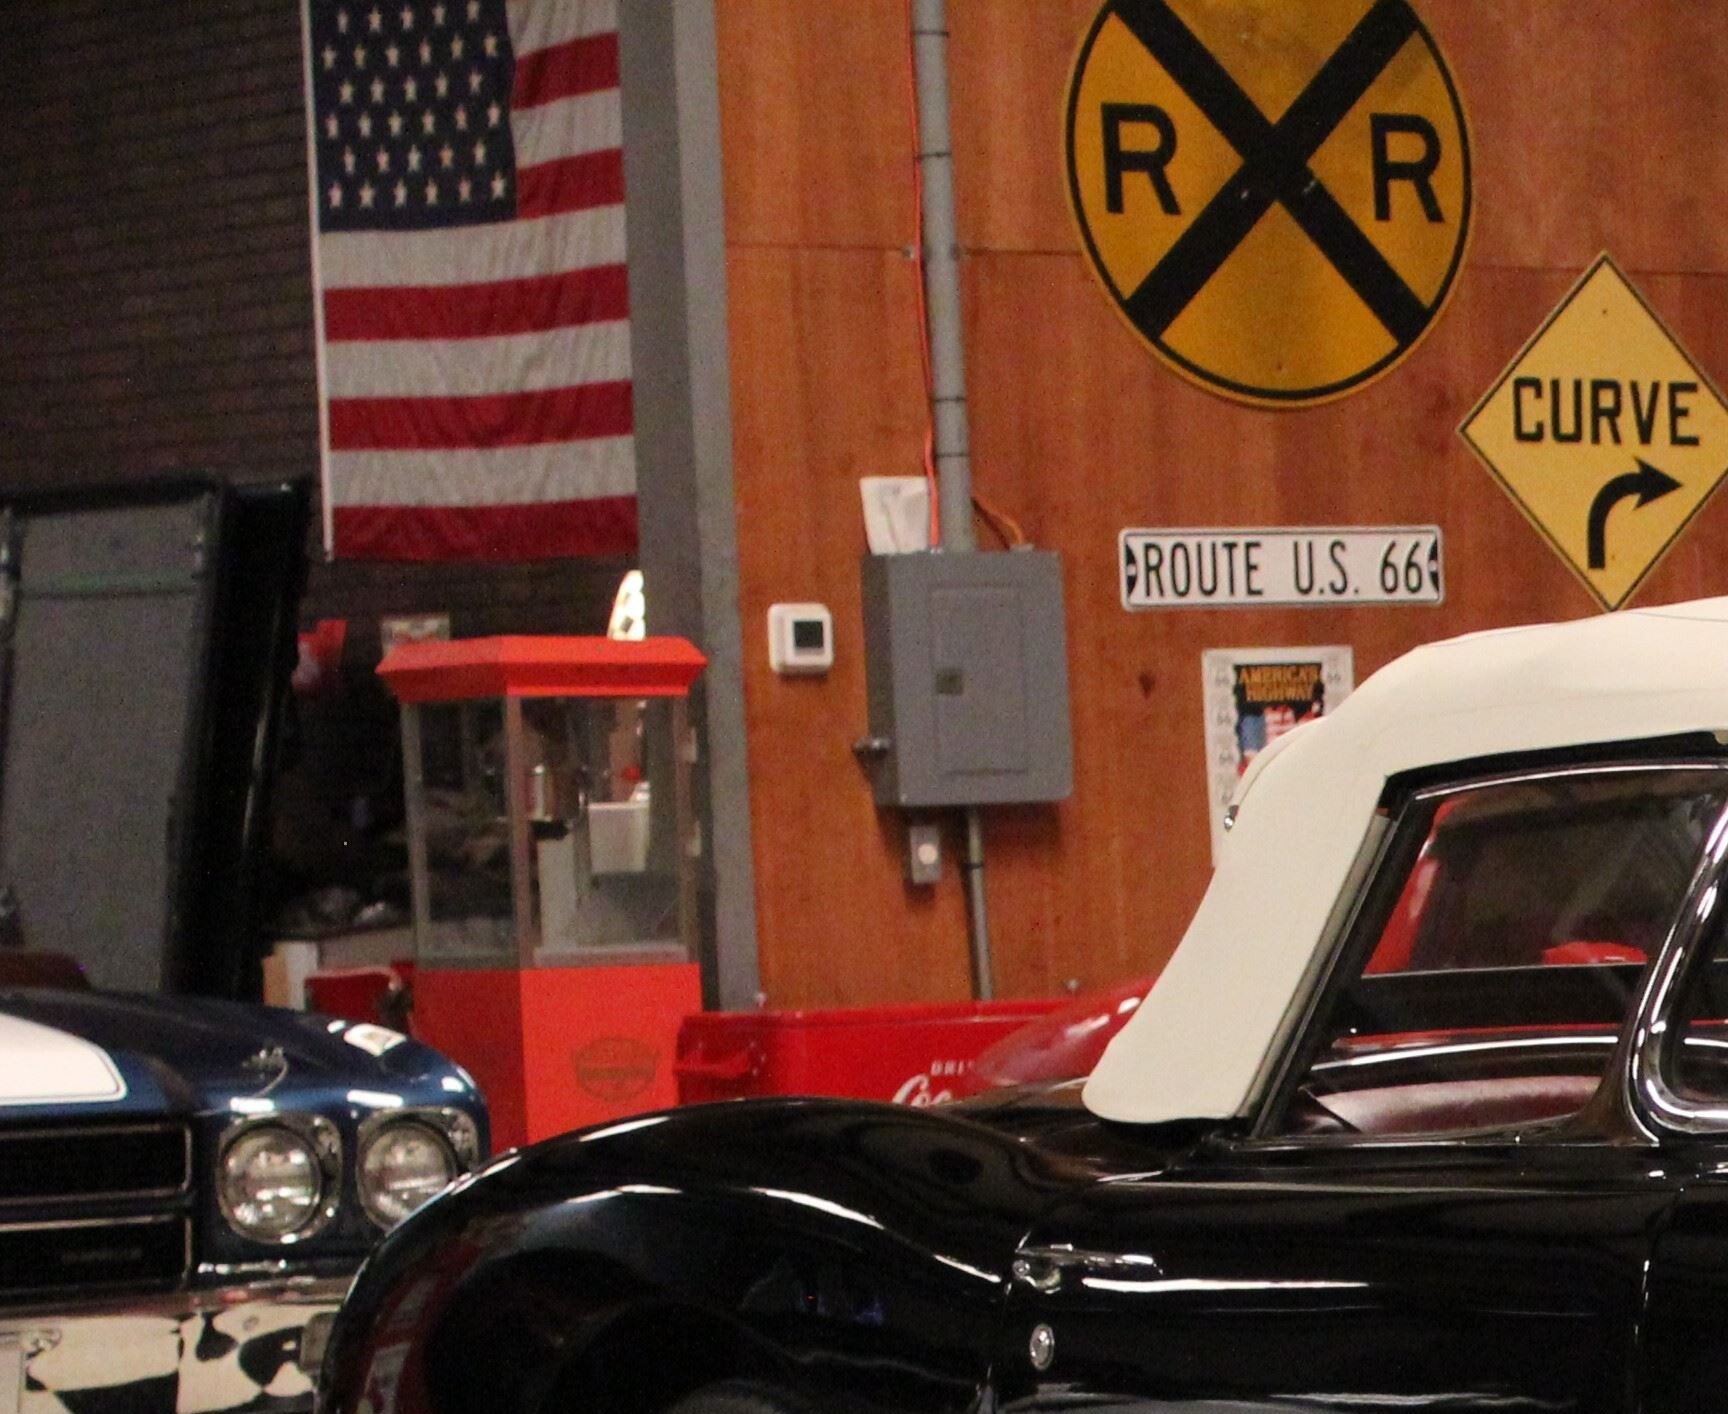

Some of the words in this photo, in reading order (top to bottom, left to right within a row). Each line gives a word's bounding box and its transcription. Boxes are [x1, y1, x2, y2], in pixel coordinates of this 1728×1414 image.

[1102, 104, 1181, 215] R
[1370, 112, 1446, 224] R
[1513, 376, 1701, 447] CURVE
[1143, 540, 1264, 597] ROUTE
[1293, 540, 1359, 595] U.S.
[1379, 540, 1424, 594] 66
